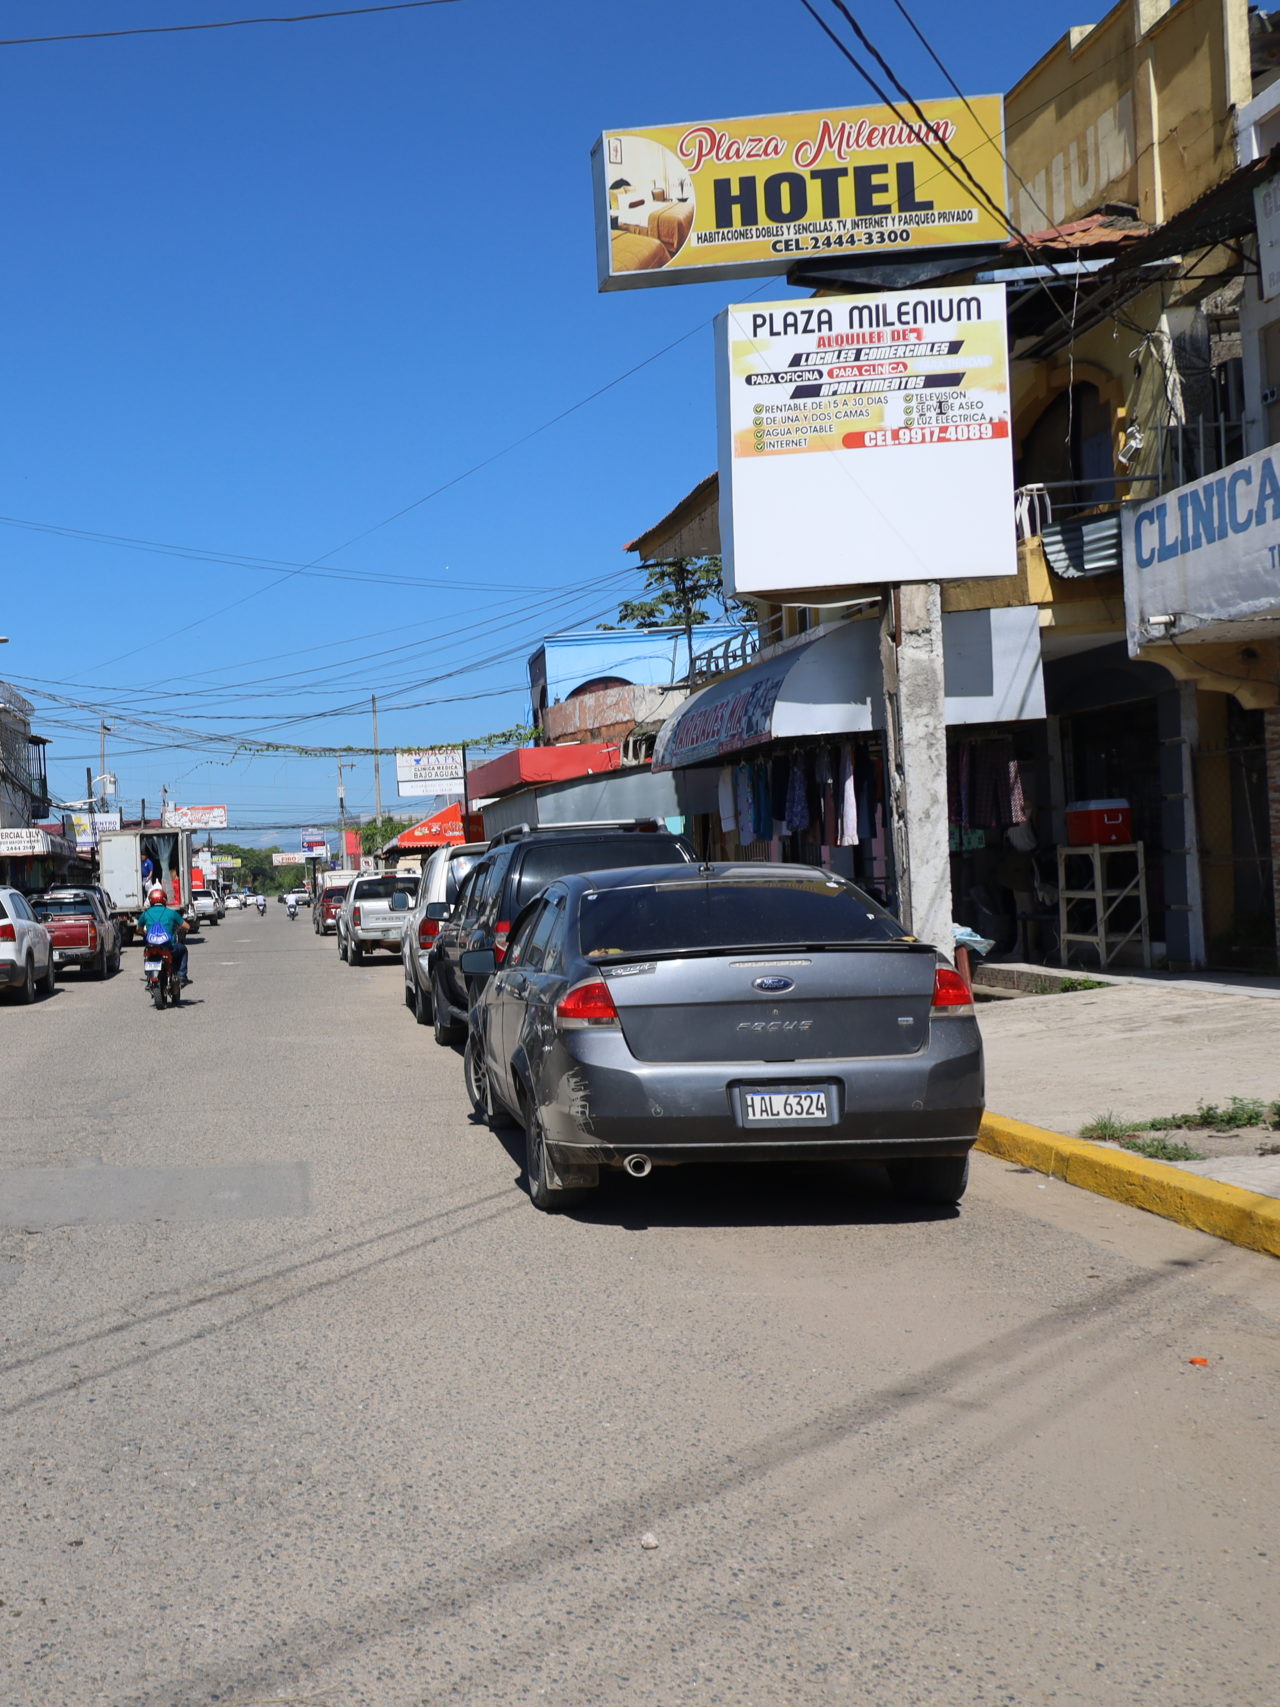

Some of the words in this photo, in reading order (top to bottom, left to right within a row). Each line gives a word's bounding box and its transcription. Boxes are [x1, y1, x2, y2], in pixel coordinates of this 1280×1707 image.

[679, 126, 785, 172] Plaza
[793, 119, 954, 168] Milenium
[713, 162, 934, 229] HOTEL
[697, 228, 753, 244] HABITACIONES
[755, 225, 784, 239] DOBLES
[786, 224, 792, 235] Y
[851, 216, 888, 231] INTERNET
[891, 215, 897, 227] Y
[898, 212, 936, 227] PARQUEO
[937, 209, 973, 223] PRIVADO
[753, 309, 833, 338] PLAZA
[849, 296, 982, 330] MILENIUM
[817, 331, 887, 349] ALQUILER
[891, 329, 910, 343] DE
[800, 349, 856, 366] LOCALES
[859, 342, 950, 361] COMERCIALES
[751, 374, 776, 385] PARA
[778, 370, 821, 383] OFICINA
[833, 367, 860, 378] PARA
[820, 376, 926, 397] APARTAMENTOS
[765, 403, 808, 414] RENTABLE
[811, 402, 824, 411] DE
[827, 400, 839, 409] 15
[841, 399, 850, 408] A
[852, 398, 865, 408] 30
[868, 396, 889, 406] DIAS
[915, 391, 967, 402] TELEVISION
[958, 401, 984, 411] ASEO
[765, 416, 779, 426] DE
[781, 415, 800, 425] UNA
[802, 413, 809, 423] Y
[812, 412, 832, 423] DOS
[835, 410, 870, 421] CAMAS
[916, 415, 933, 425] LUZ
[765, 427, 793, 438] AGUA
[795, 424, 834, 435] POTABLE
[765, 438, 808, 449] INTERNET
[736, 1020, 814, 1032] FOCUS
[746, 1096, 780, 1117] HAL
[783, 1094, 825, 1116] 6324
